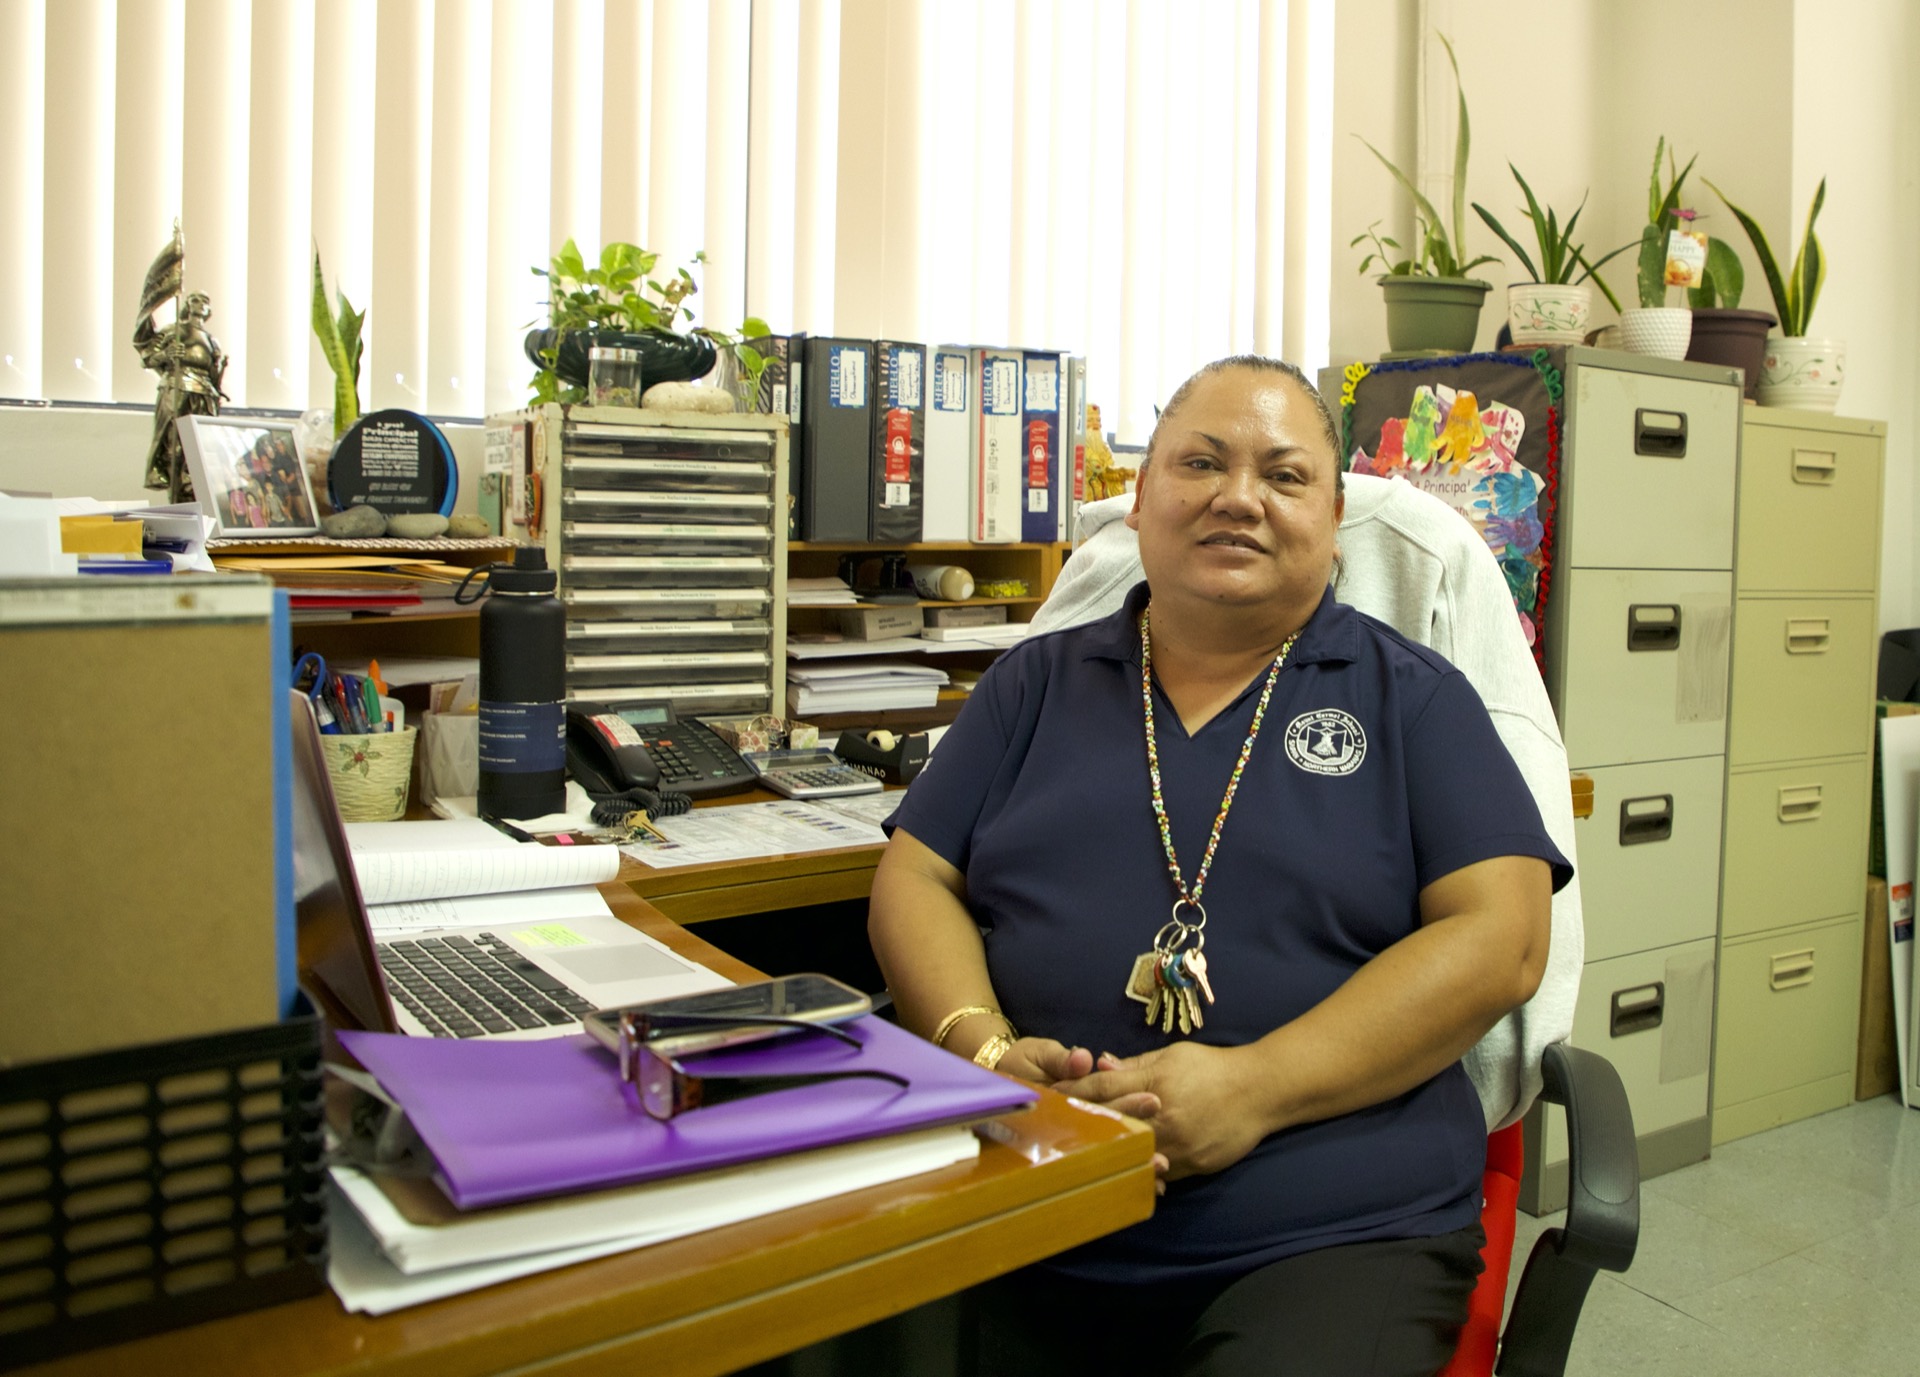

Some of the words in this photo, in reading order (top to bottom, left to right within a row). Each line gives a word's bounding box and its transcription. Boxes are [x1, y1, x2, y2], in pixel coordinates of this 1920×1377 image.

[831, 356, 840, 398] HELLO
[890, 358, 898, 398] HELLO
[935, 362, 943, 402] HELLO
[984, 367, 993, 406] HELLO
[362, 427, 418, 437] Principal
[1303, 760, 1338, 773] NORTHERN
